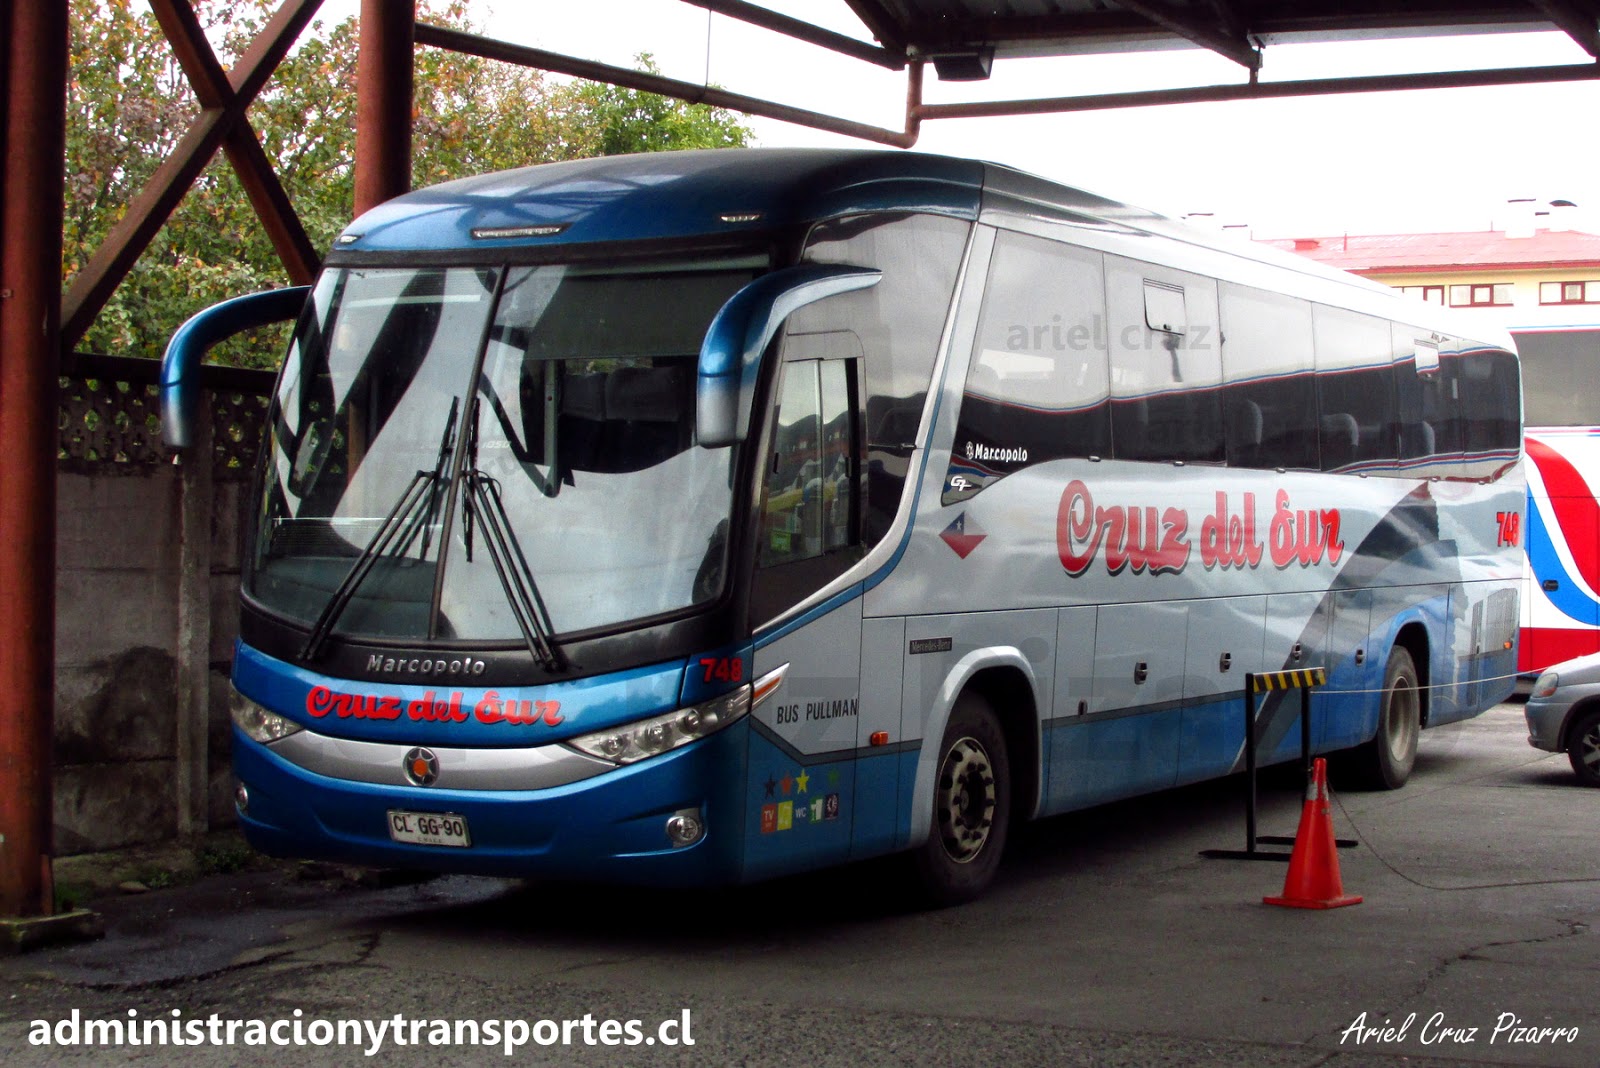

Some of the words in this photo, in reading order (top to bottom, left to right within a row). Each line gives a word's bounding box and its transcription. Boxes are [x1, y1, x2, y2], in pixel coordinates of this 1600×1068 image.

[975, 443, 1028, 463] Marcopolo
[1056, 479, 1192, 577] Cruz
[1201, 489, 1265, 569] del
[1269, 487, 1345, 568] Sur
[1496, 511, 1520, 547] 748
[366, 654, 486, 677] Marcopolo
[699, 657, 743, 683] 748
[306, 685, 402, 719] Cruz
[407, 690, 470, 723] del
[474, 690, 565, 727] Sur
[777, 704, 799, 724] BUS
[806, 699, 858, 721] PULLMAN
